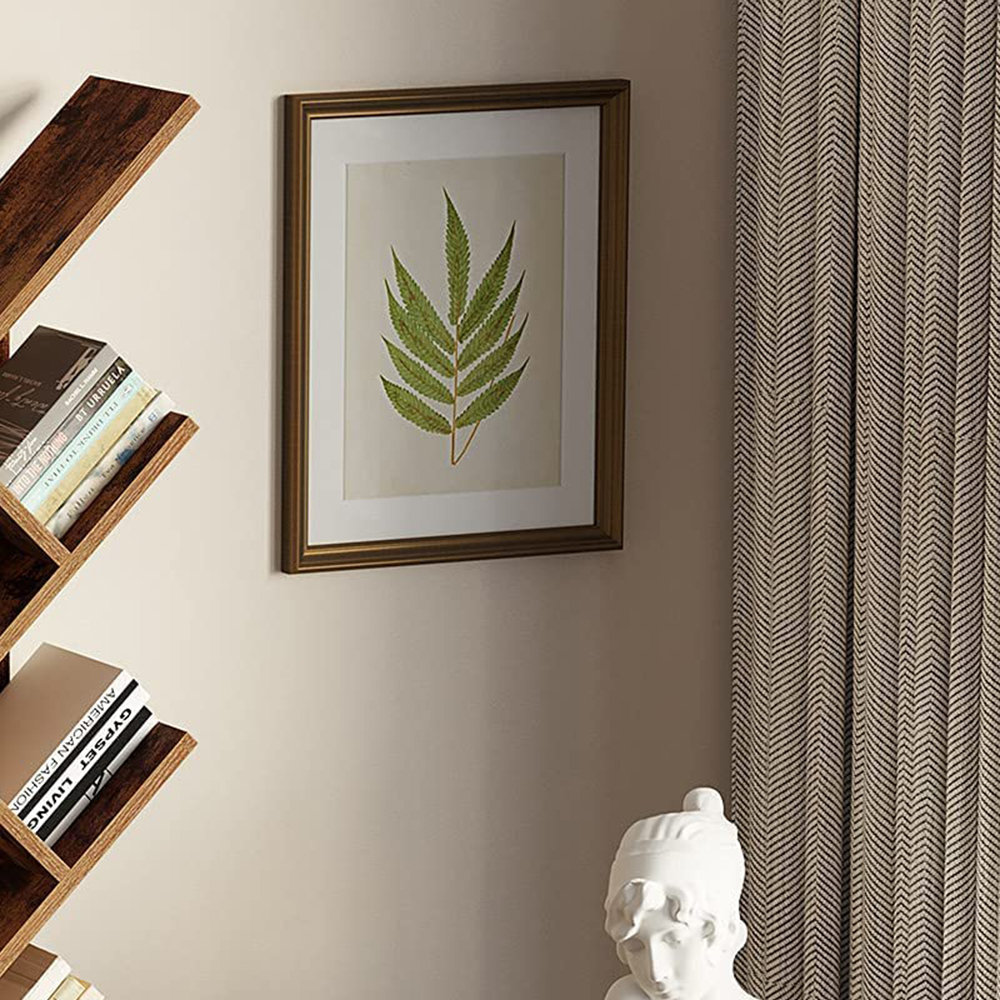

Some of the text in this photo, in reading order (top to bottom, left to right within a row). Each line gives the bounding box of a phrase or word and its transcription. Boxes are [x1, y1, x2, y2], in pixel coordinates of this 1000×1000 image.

[85, 364, 126, 408] URRUELA
[9, 688, 117, 813] AMERICAN FASHION
[26, 706, 132, 830] GYPSET LIVING
